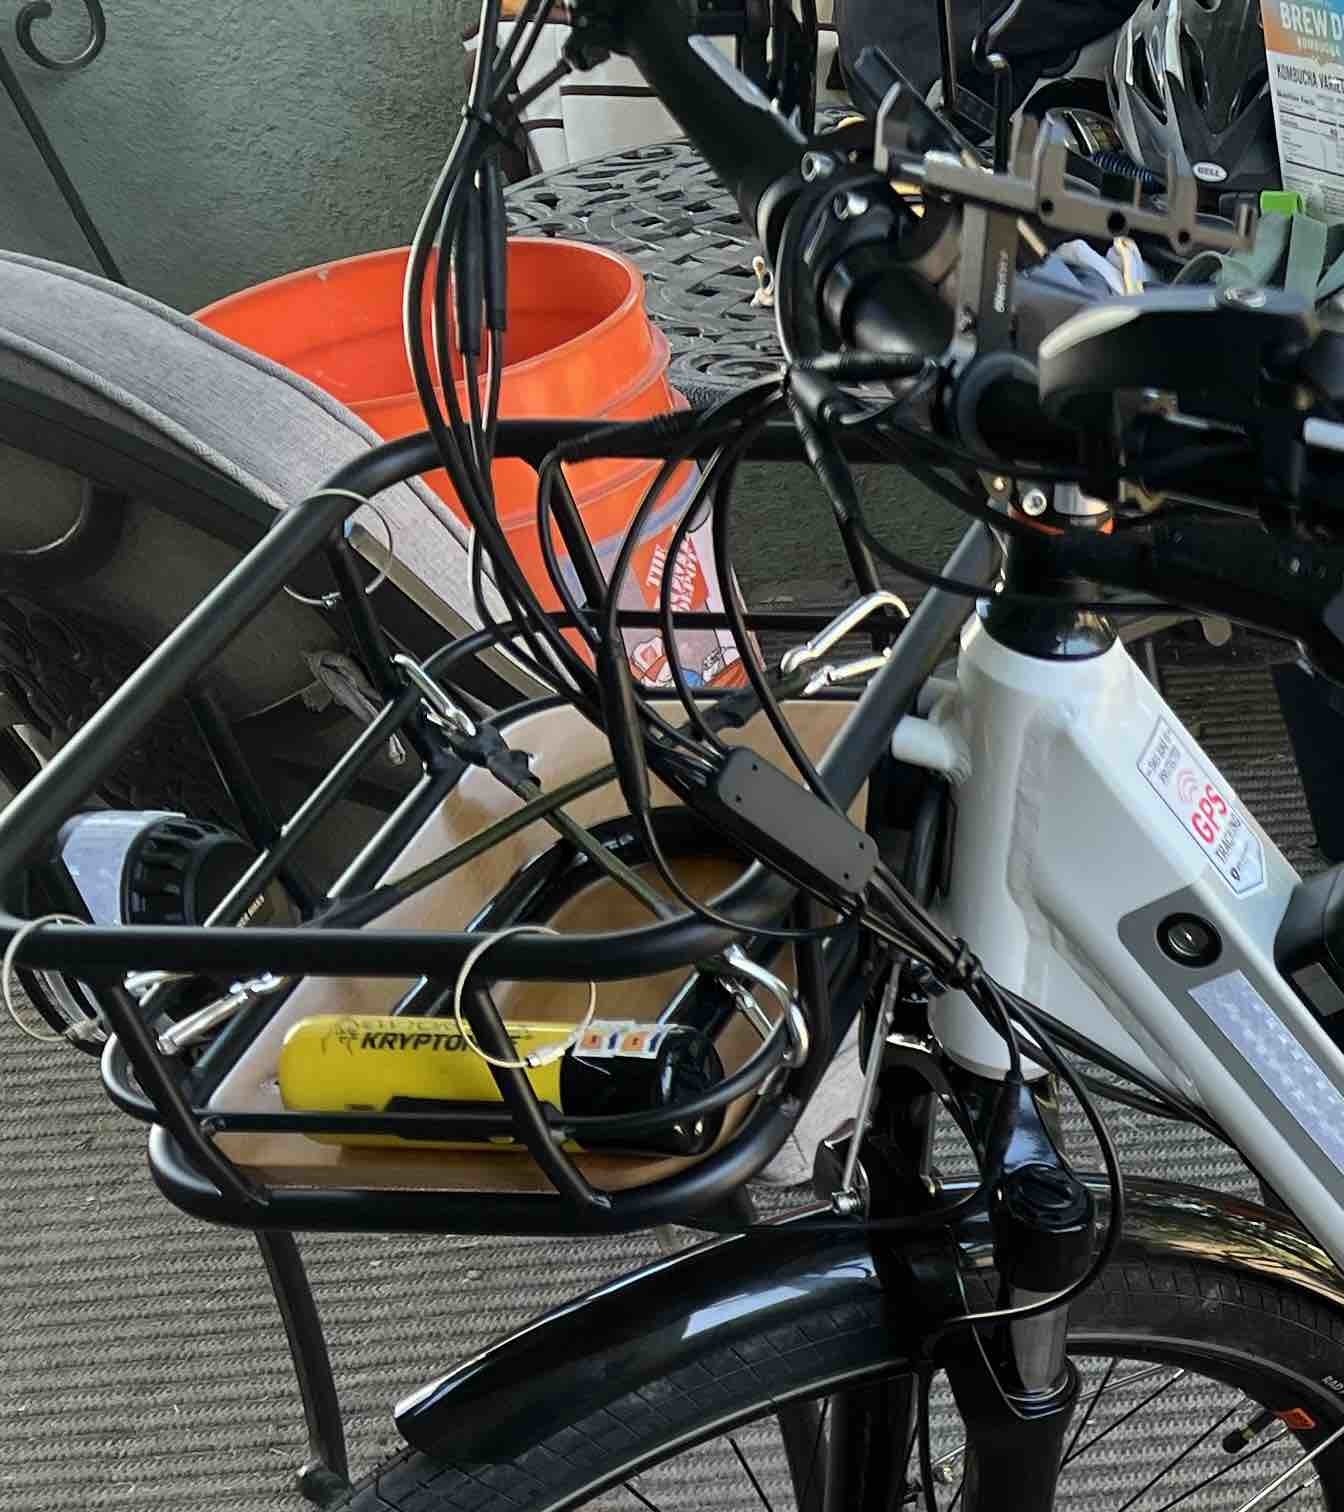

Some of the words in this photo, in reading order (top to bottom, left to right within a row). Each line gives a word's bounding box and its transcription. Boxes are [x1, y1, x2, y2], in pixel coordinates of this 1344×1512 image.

[1279, 3, 1328, 39] BREW
[1277, 63, 1317, 90] KOMBUCHA
[1191, 784, 1229, 845] GPS
